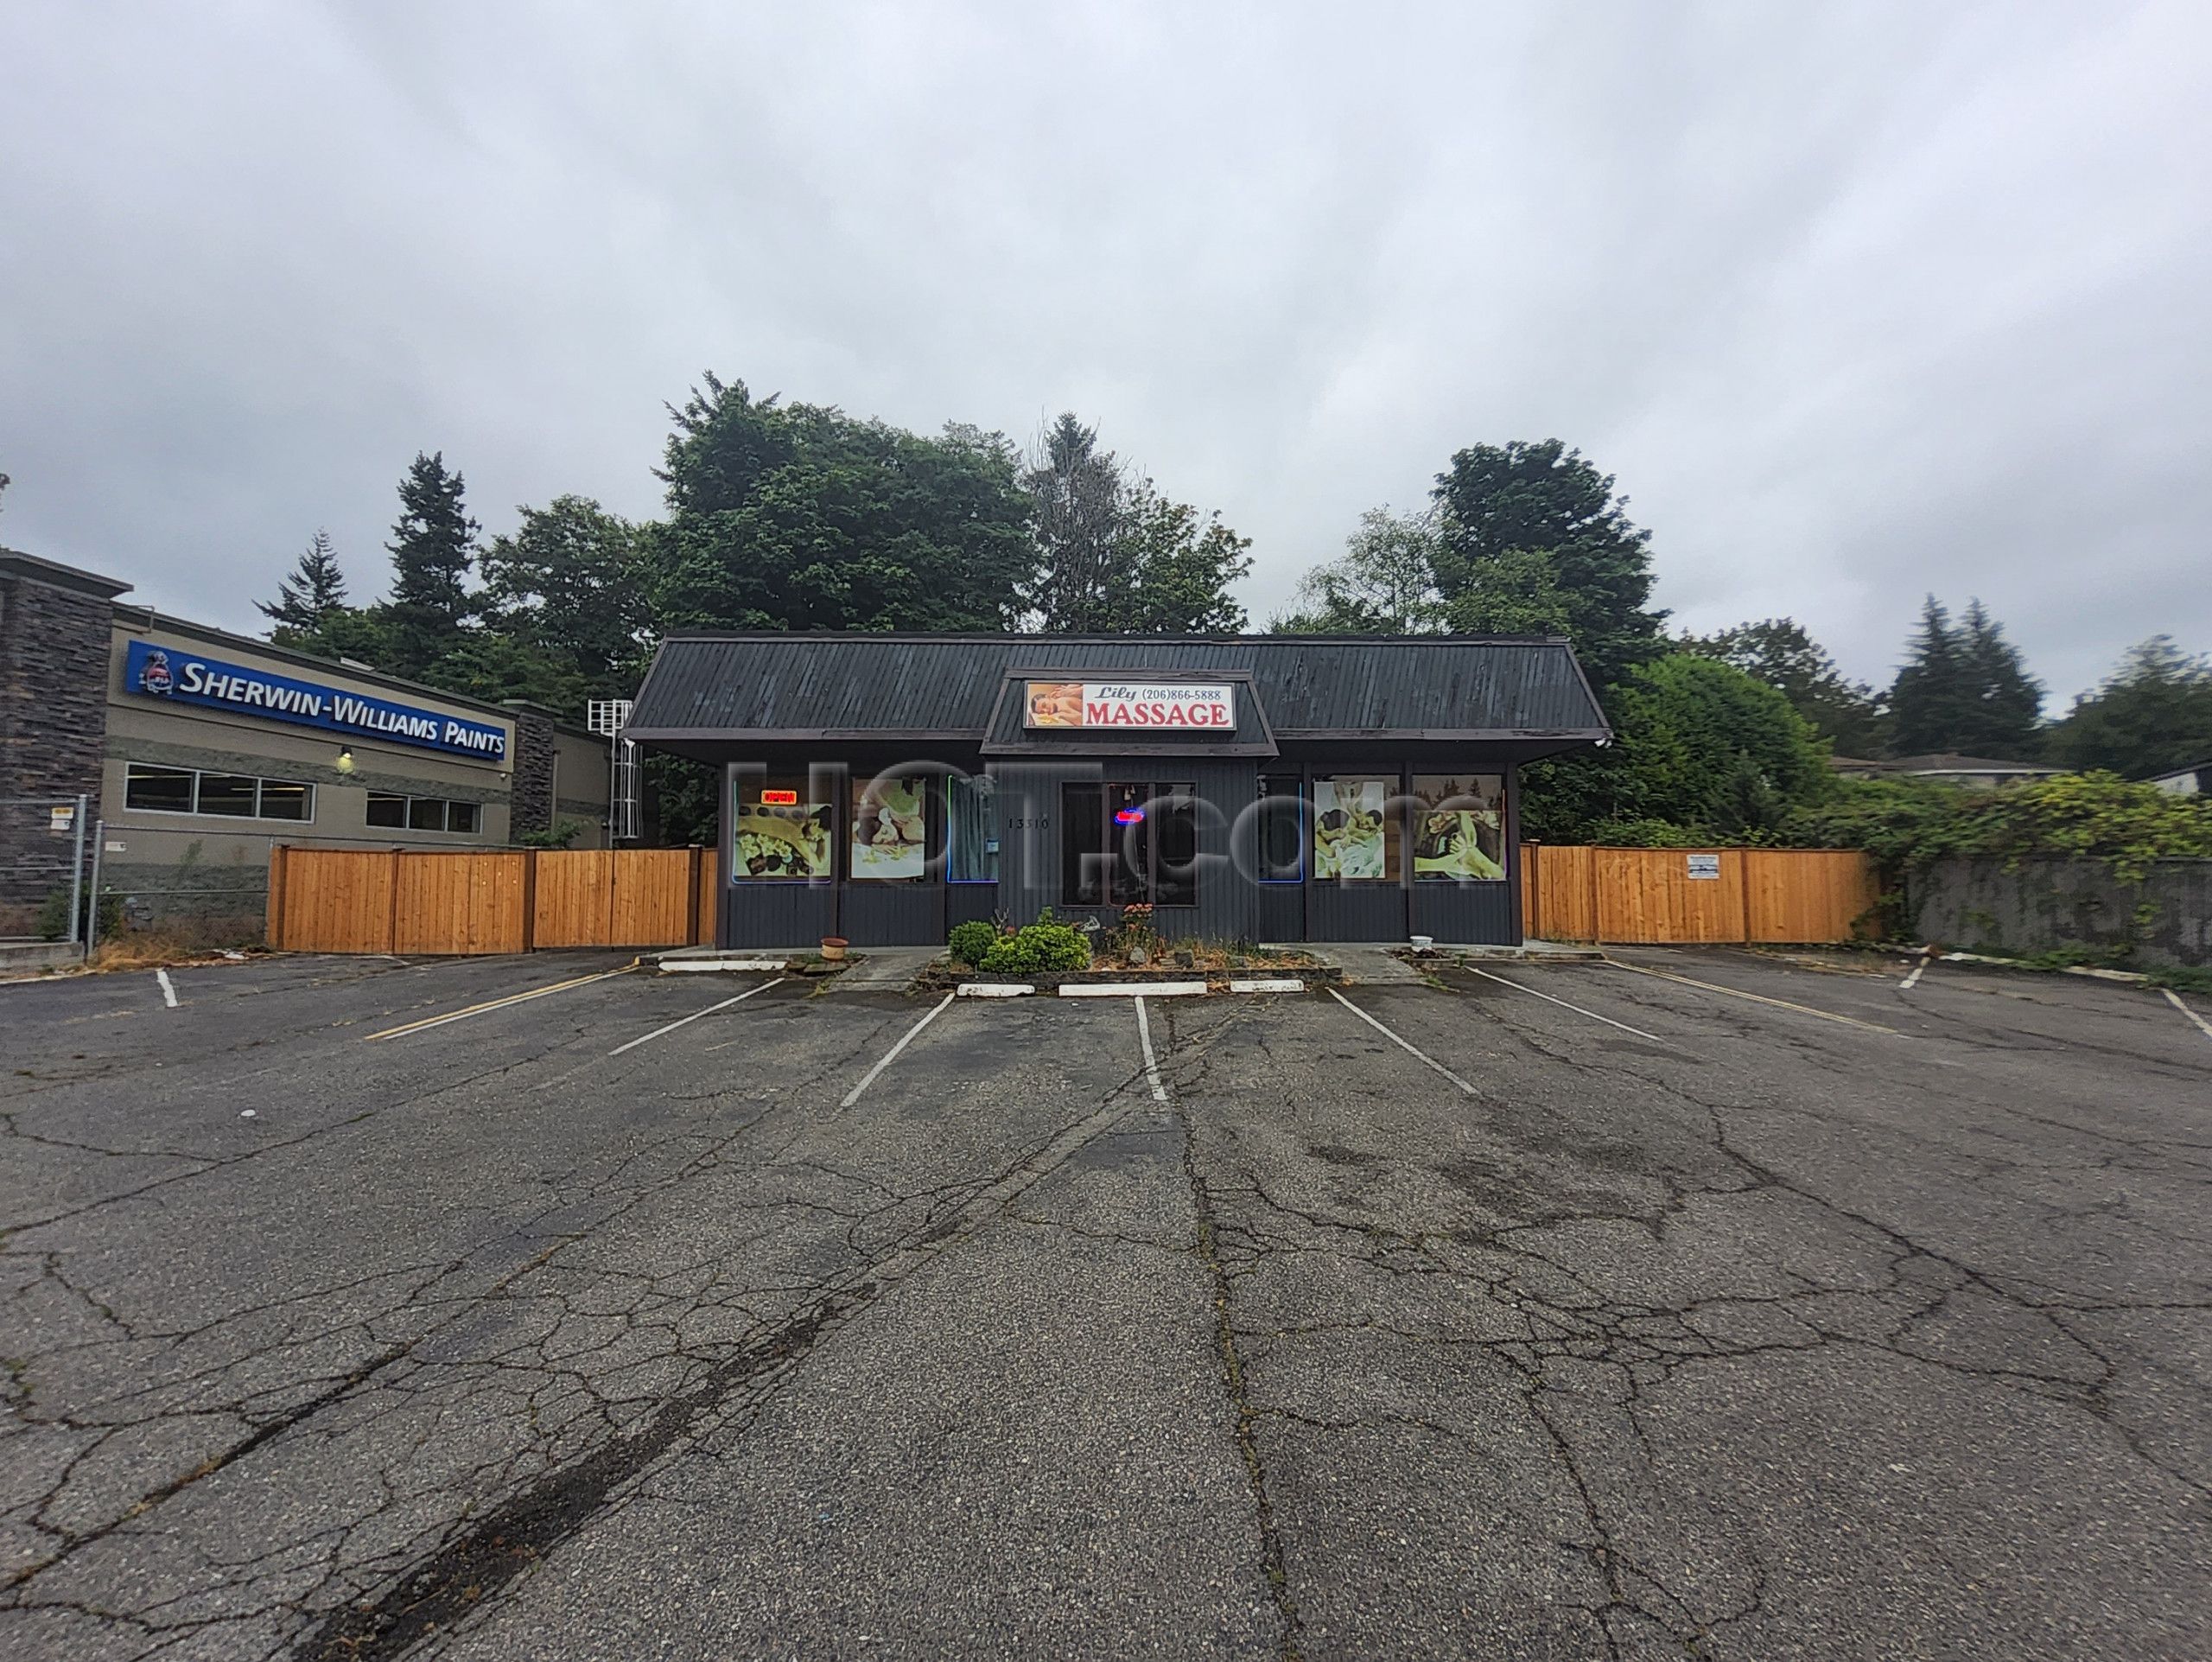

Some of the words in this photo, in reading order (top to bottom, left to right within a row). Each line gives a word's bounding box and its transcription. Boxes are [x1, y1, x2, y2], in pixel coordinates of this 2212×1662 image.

[1094, 686, 1137, 702] Lily
[1142, 689, 1222, 701] (206)866-5888
[179, 662, 438, 741] SHERWIN-WILLIAMS
[444, 721, 505, 754] PAINTS
[1085, 703, 1230, 726] MASSAGE
